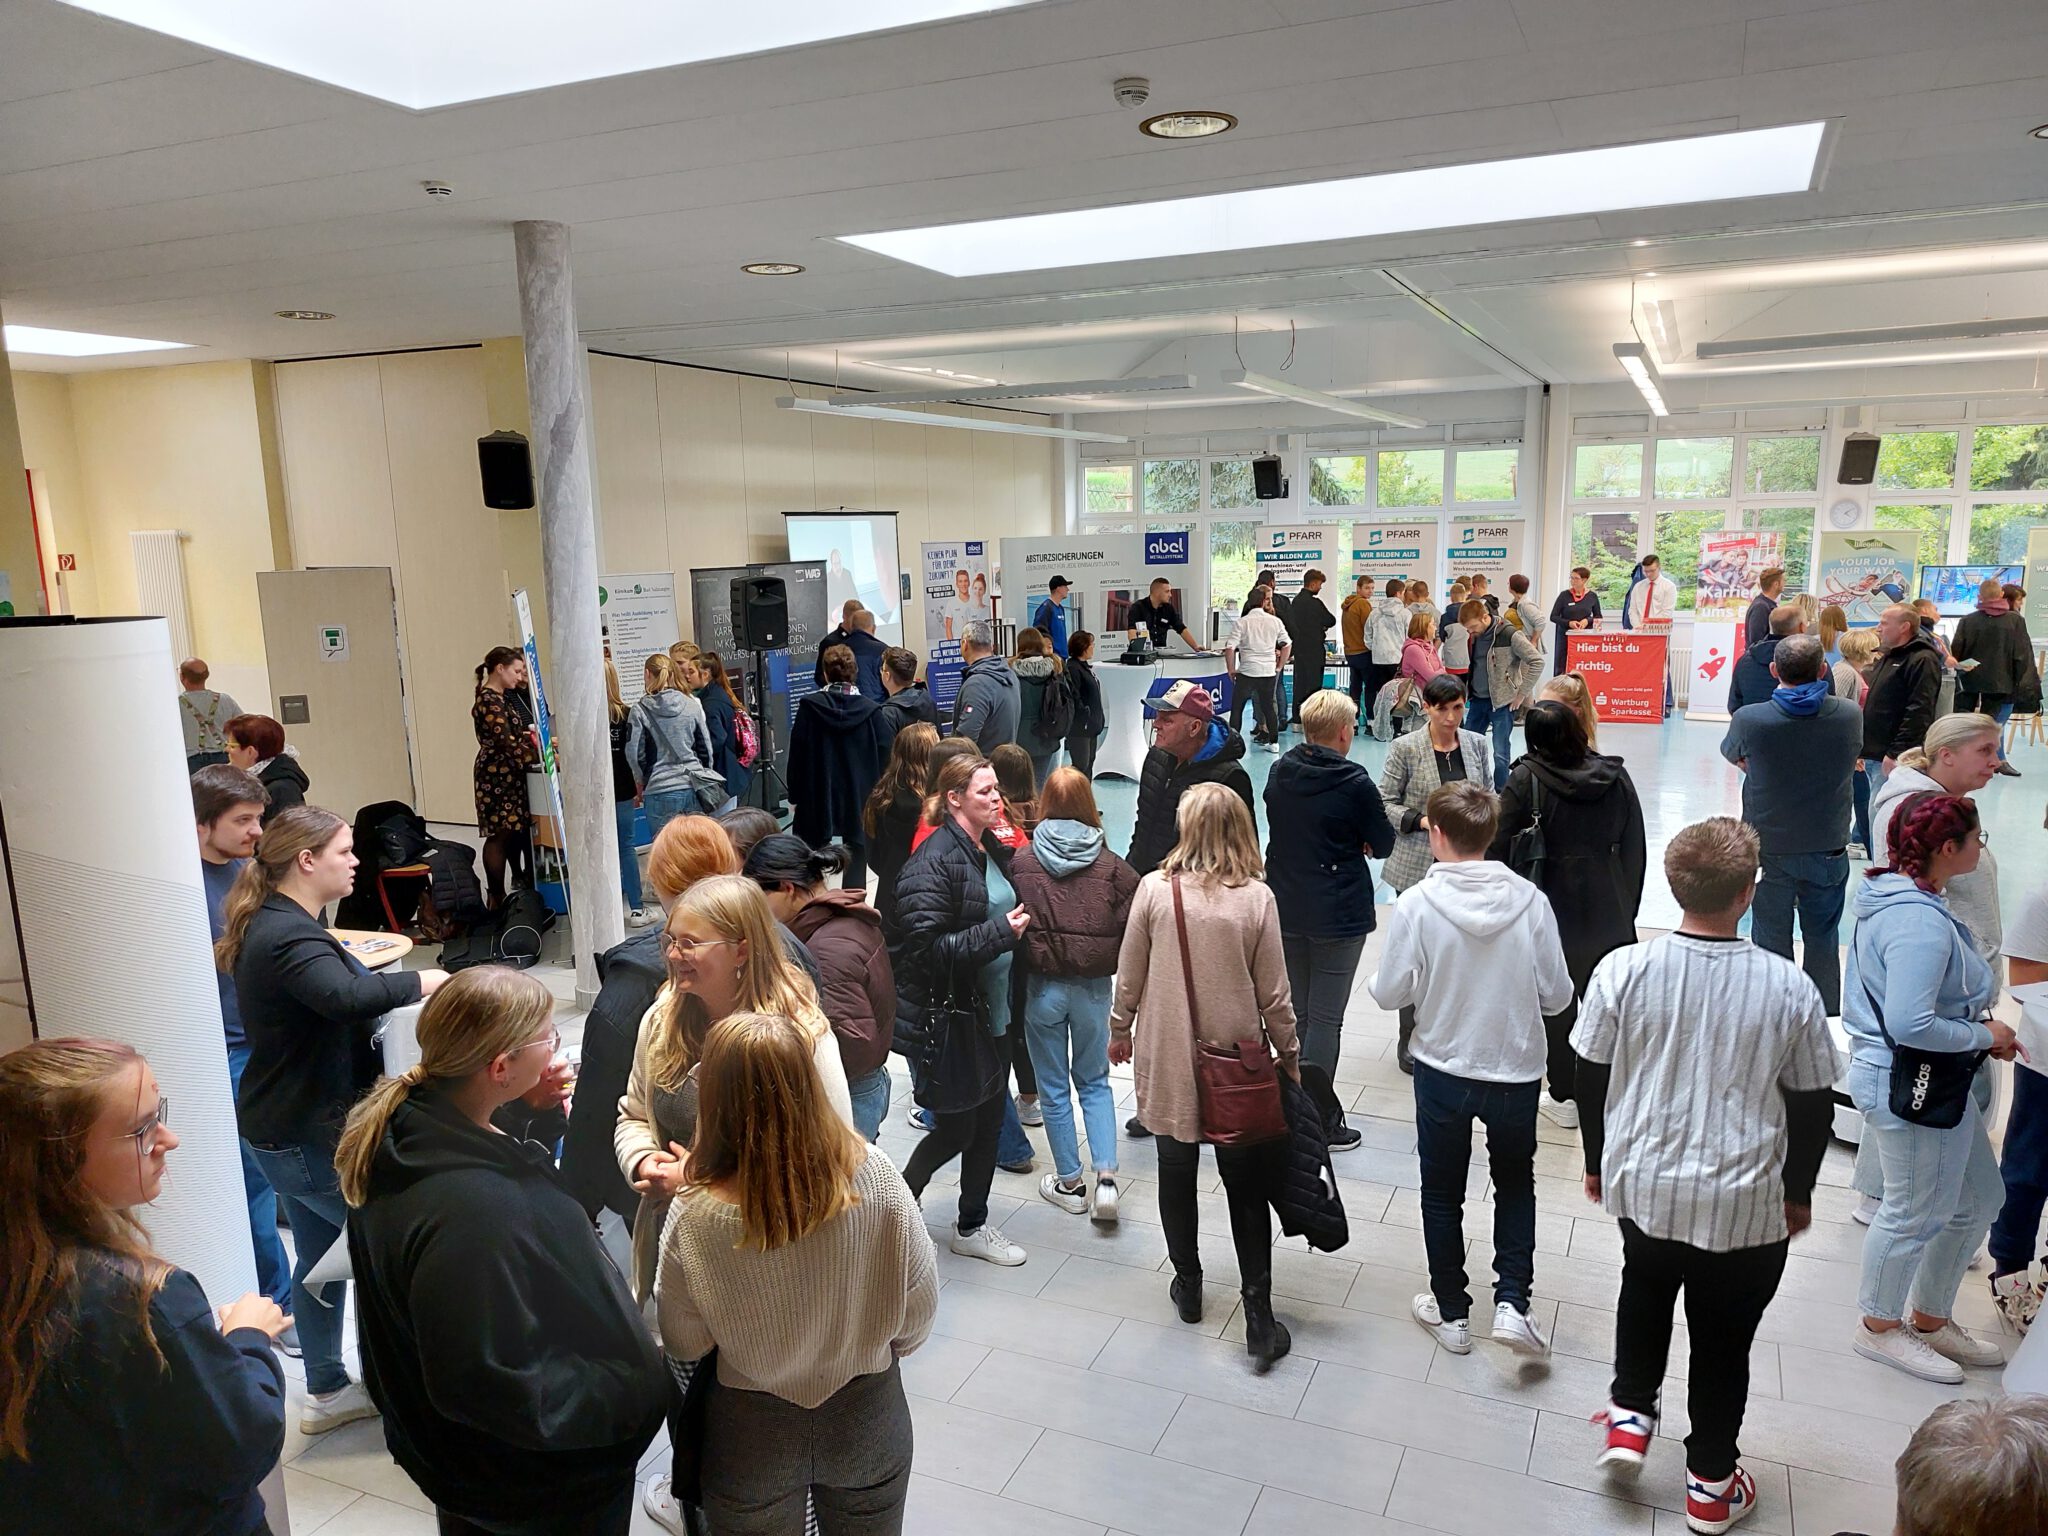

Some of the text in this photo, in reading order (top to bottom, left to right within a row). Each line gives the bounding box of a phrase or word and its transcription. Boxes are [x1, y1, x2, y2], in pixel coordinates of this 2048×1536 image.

[1289, 531, 1322, 540] PFARR
[1386, 530, 1421, 538] PFARR
[1478, 528, 1509, 537] PFARR
[928, 549, 958, 560] KEINEN PLAN
[1026, 551, 1104, 563] ABSTURZSICHERUNGEN
[1840, 557, 1896, 566] YOUR JOB
[1830, 566, 1890, 576] YOUR WAY
[1704, 585, 1754, 598] Karrier
[713, 614, 730, 624] DEIN
[714, 626, 732, 637] KARR
[774, 644, 819, 658] WIRKLICHKE
[1576, 642, 1640, 652] Hier bist du
[718, 650, 756, 662] NIVERSUM
[1576, 661, 1614, 672] richtig.
[1611, 698, 1649, 707] Wartburg
[1611, 707, 1652, 716] Sparkasse
[1912, 1064, 1931, 1110] adidas
